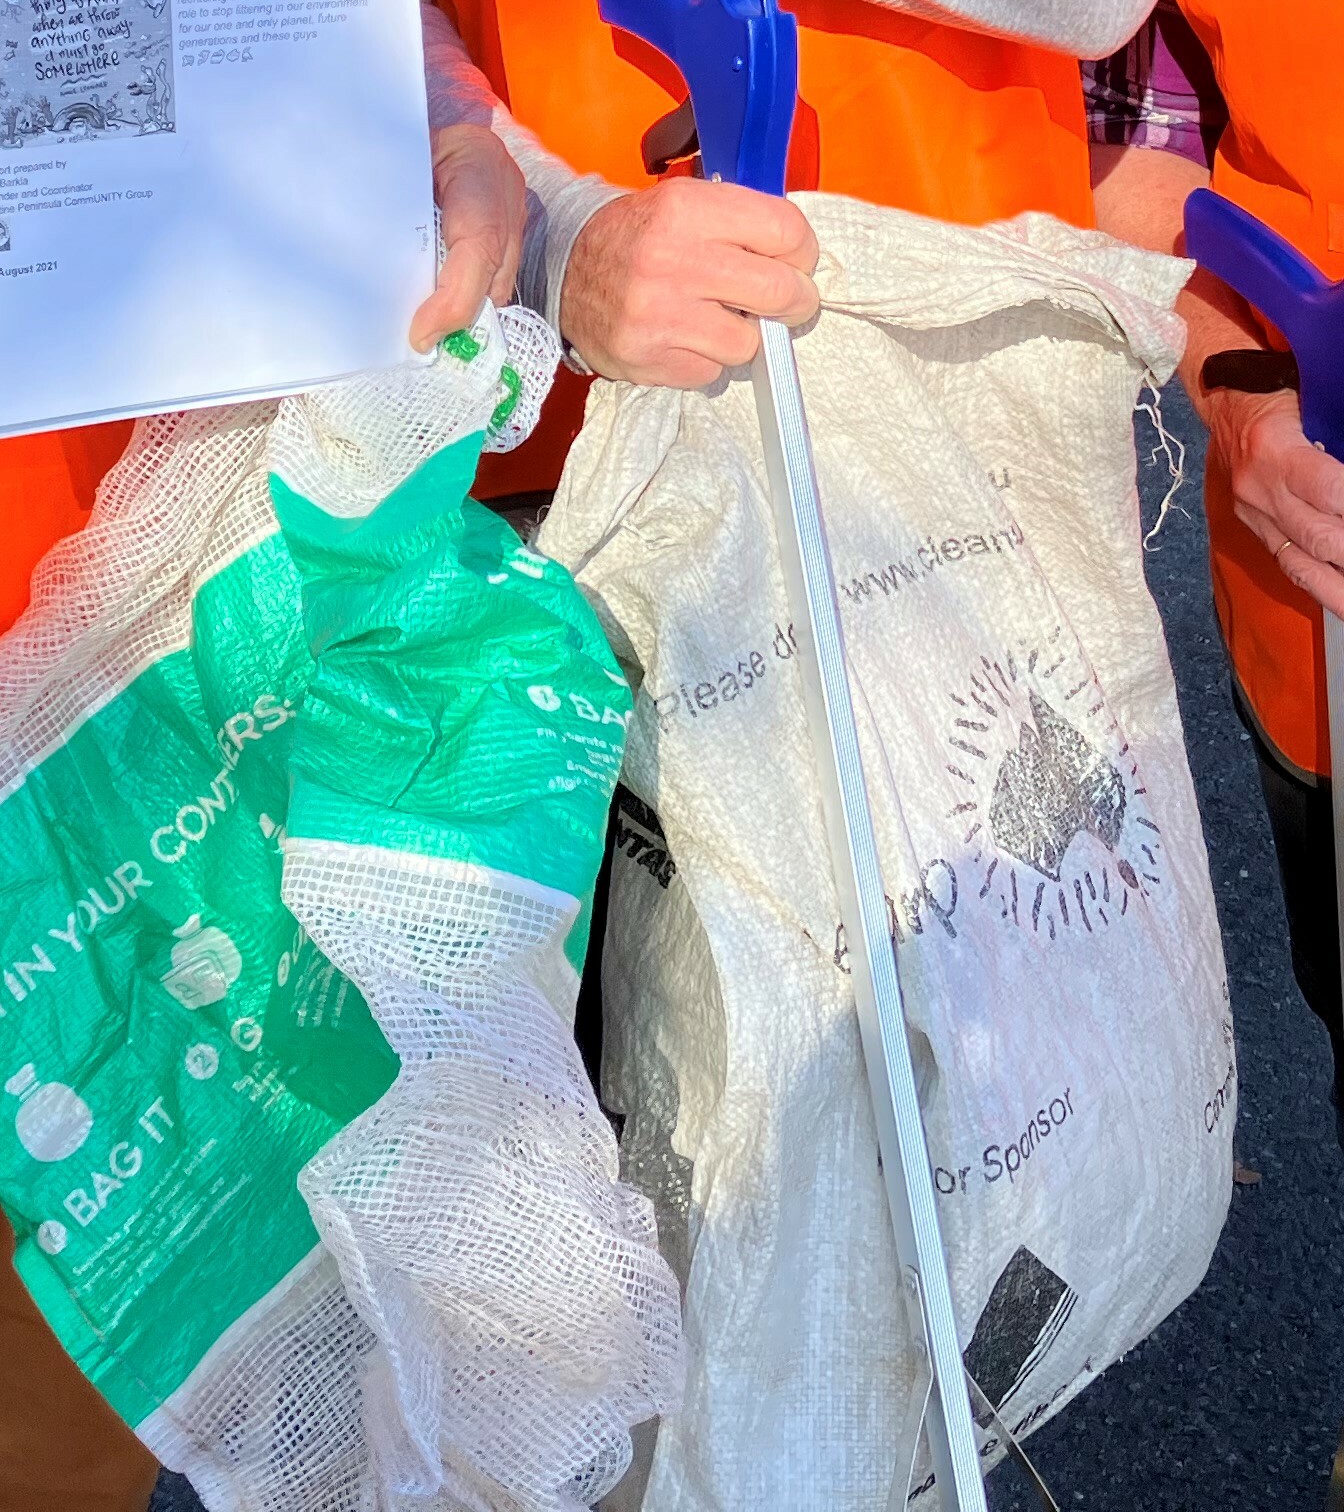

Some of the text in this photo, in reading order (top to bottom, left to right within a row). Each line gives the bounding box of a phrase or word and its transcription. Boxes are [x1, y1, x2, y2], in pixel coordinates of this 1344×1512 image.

[13, 160, 54, 176] prepared
[55, 159, 67, 170] by
[21, 187, 39, 199] and
[40, 183, 93, 197] Coordinator
[125, 189, 154, 201] Group
[35, 260, 58, 273] 2021
[568, 692, 634, 733] BA
[654, 651, 766, 734] Please
[3, 943, 57, 1002] IN
[48, 860, 154, 953] YOUR
[982, 1087, 1074, 1184] Sponsor
[63, 1140, 143, 1228] BAG
[138, 1095, 175, 1144] IT
